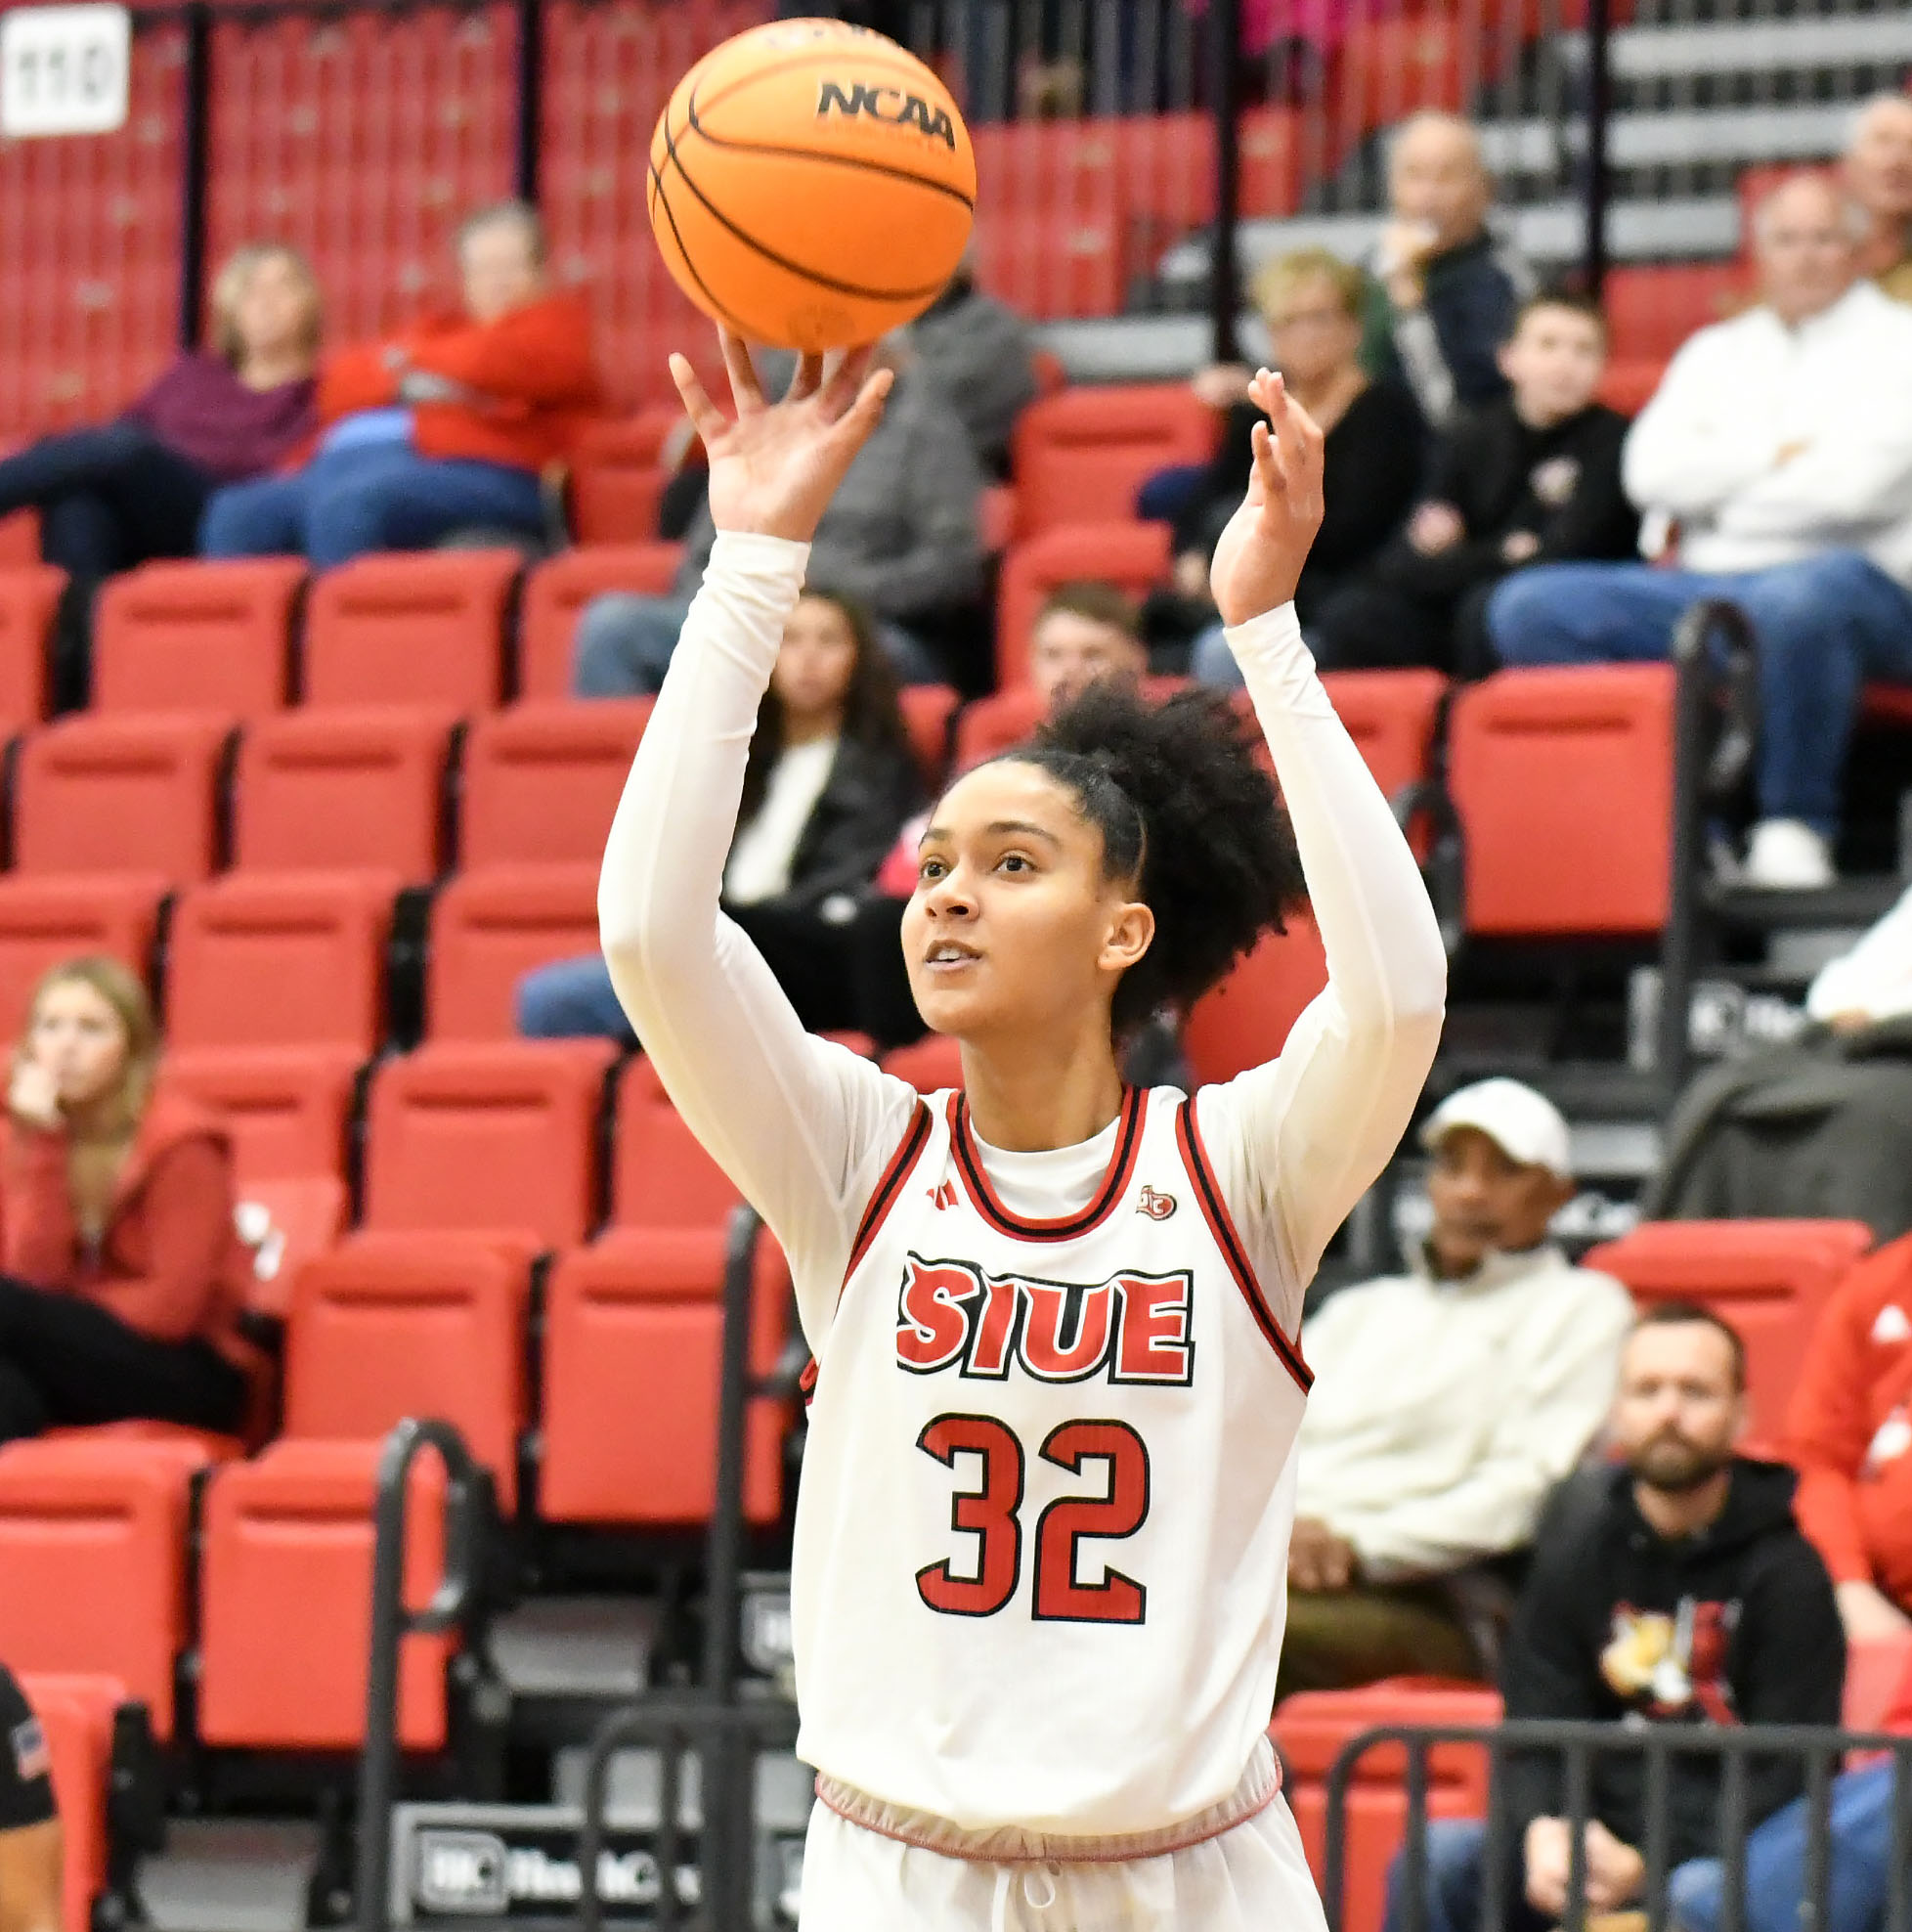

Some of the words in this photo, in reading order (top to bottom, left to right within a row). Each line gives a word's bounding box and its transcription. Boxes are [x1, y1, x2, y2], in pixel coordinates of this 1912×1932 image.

[816, 82, 956, 152] NCAA
[897, 1250, 1195, 1386] SIUE
[915, 1412, 1151, 1624] 32
